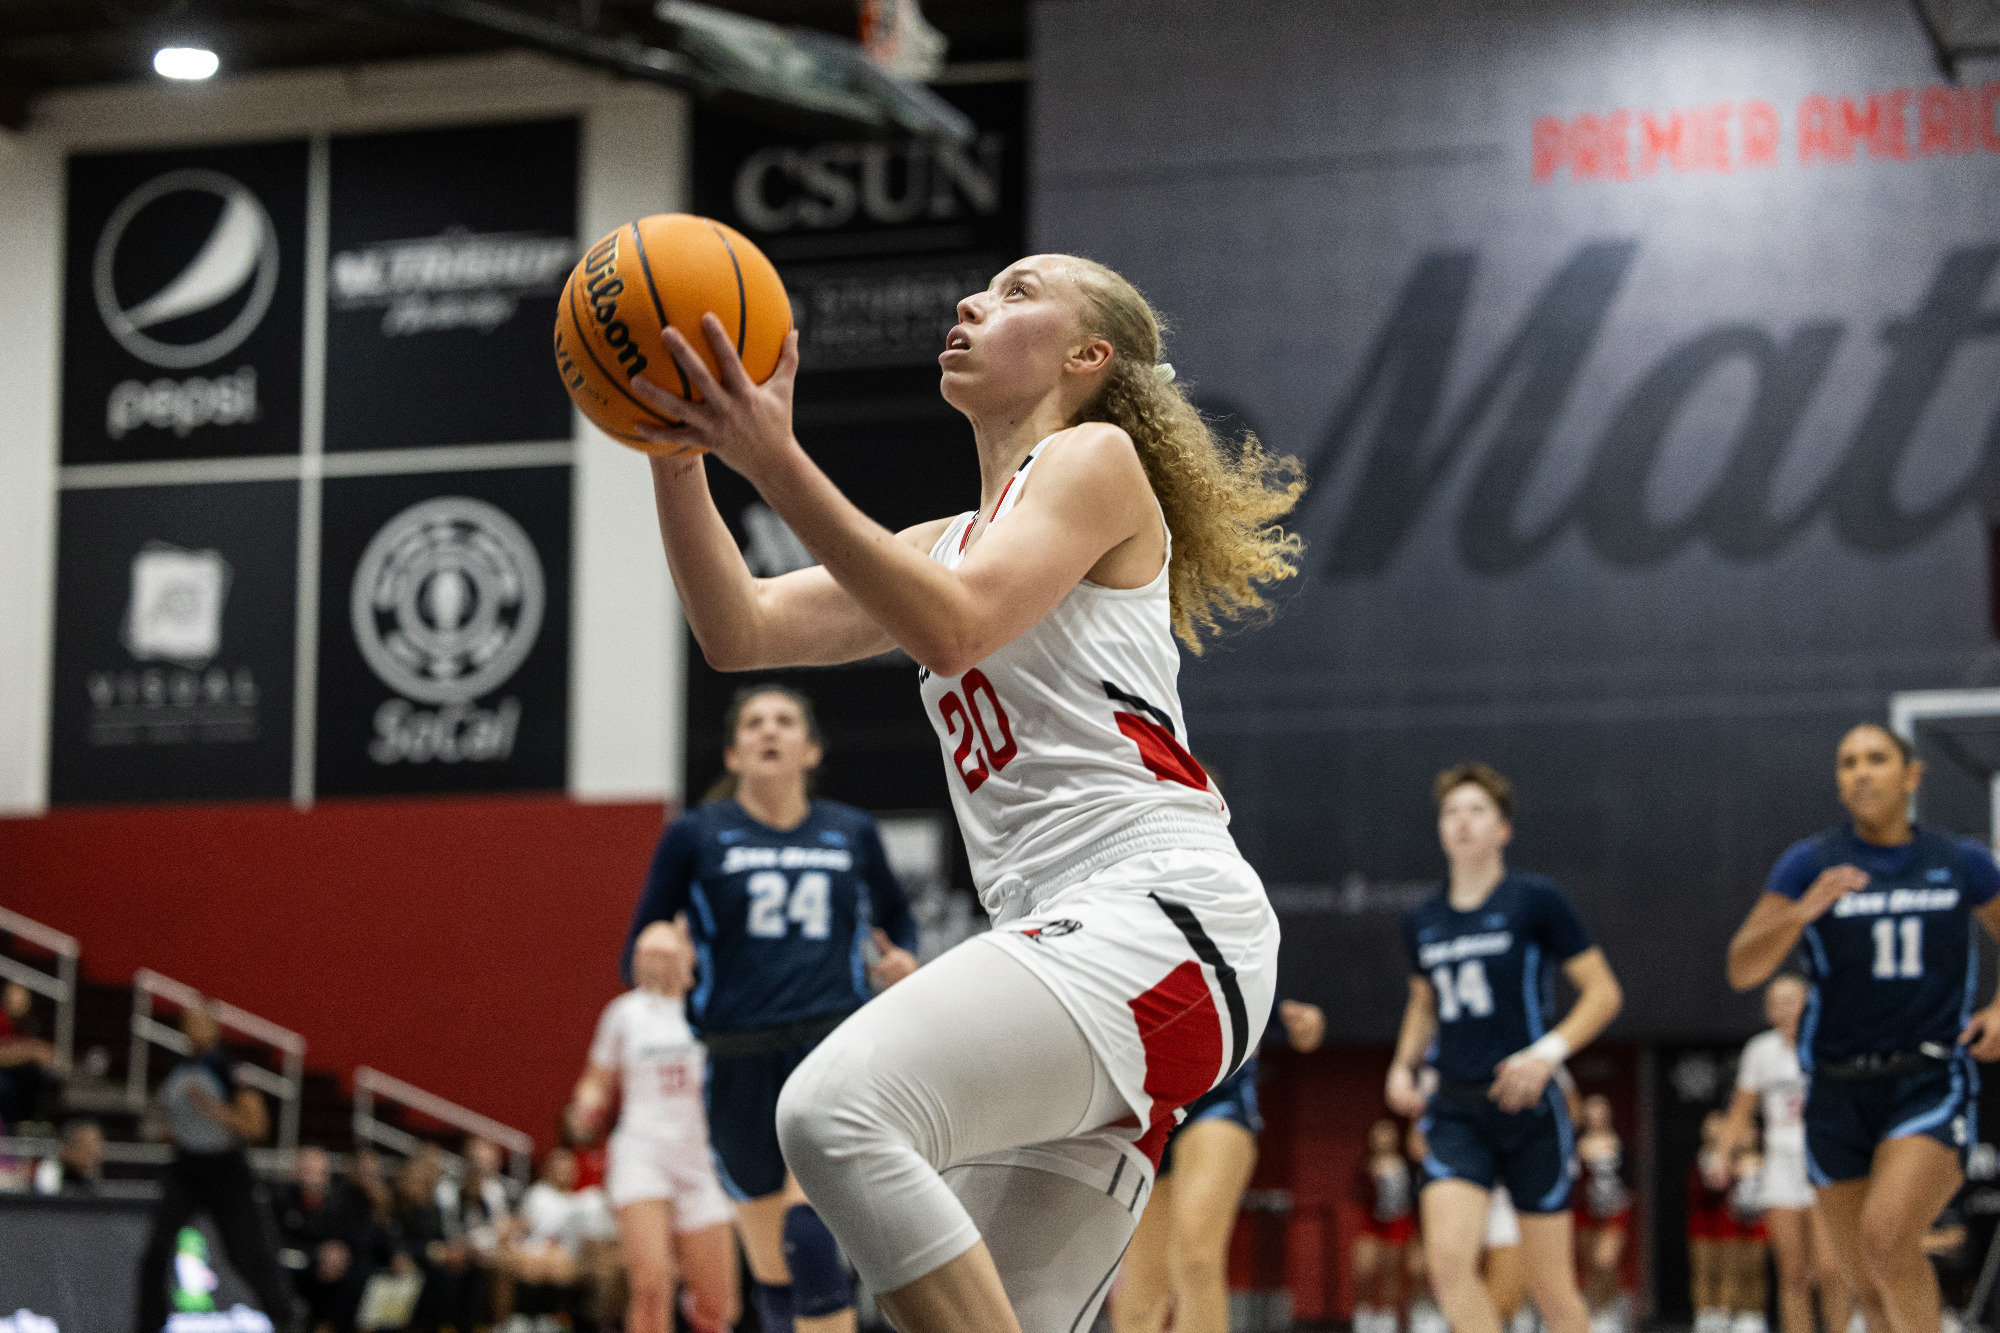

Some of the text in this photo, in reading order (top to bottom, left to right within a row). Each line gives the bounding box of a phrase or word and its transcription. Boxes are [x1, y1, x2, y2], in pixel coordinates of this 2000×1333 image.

[733, 134, 1002, 232] CSUN
[585, 232, 648, 379] Wilson
[106, 366, 257, 438] pepsi
[938, 668, 1018, 794] 20
[747, 870, 832, 940] 24
[1872, 916, 1924, 980] 11
[1432, 963, 1495, 1022] 14
